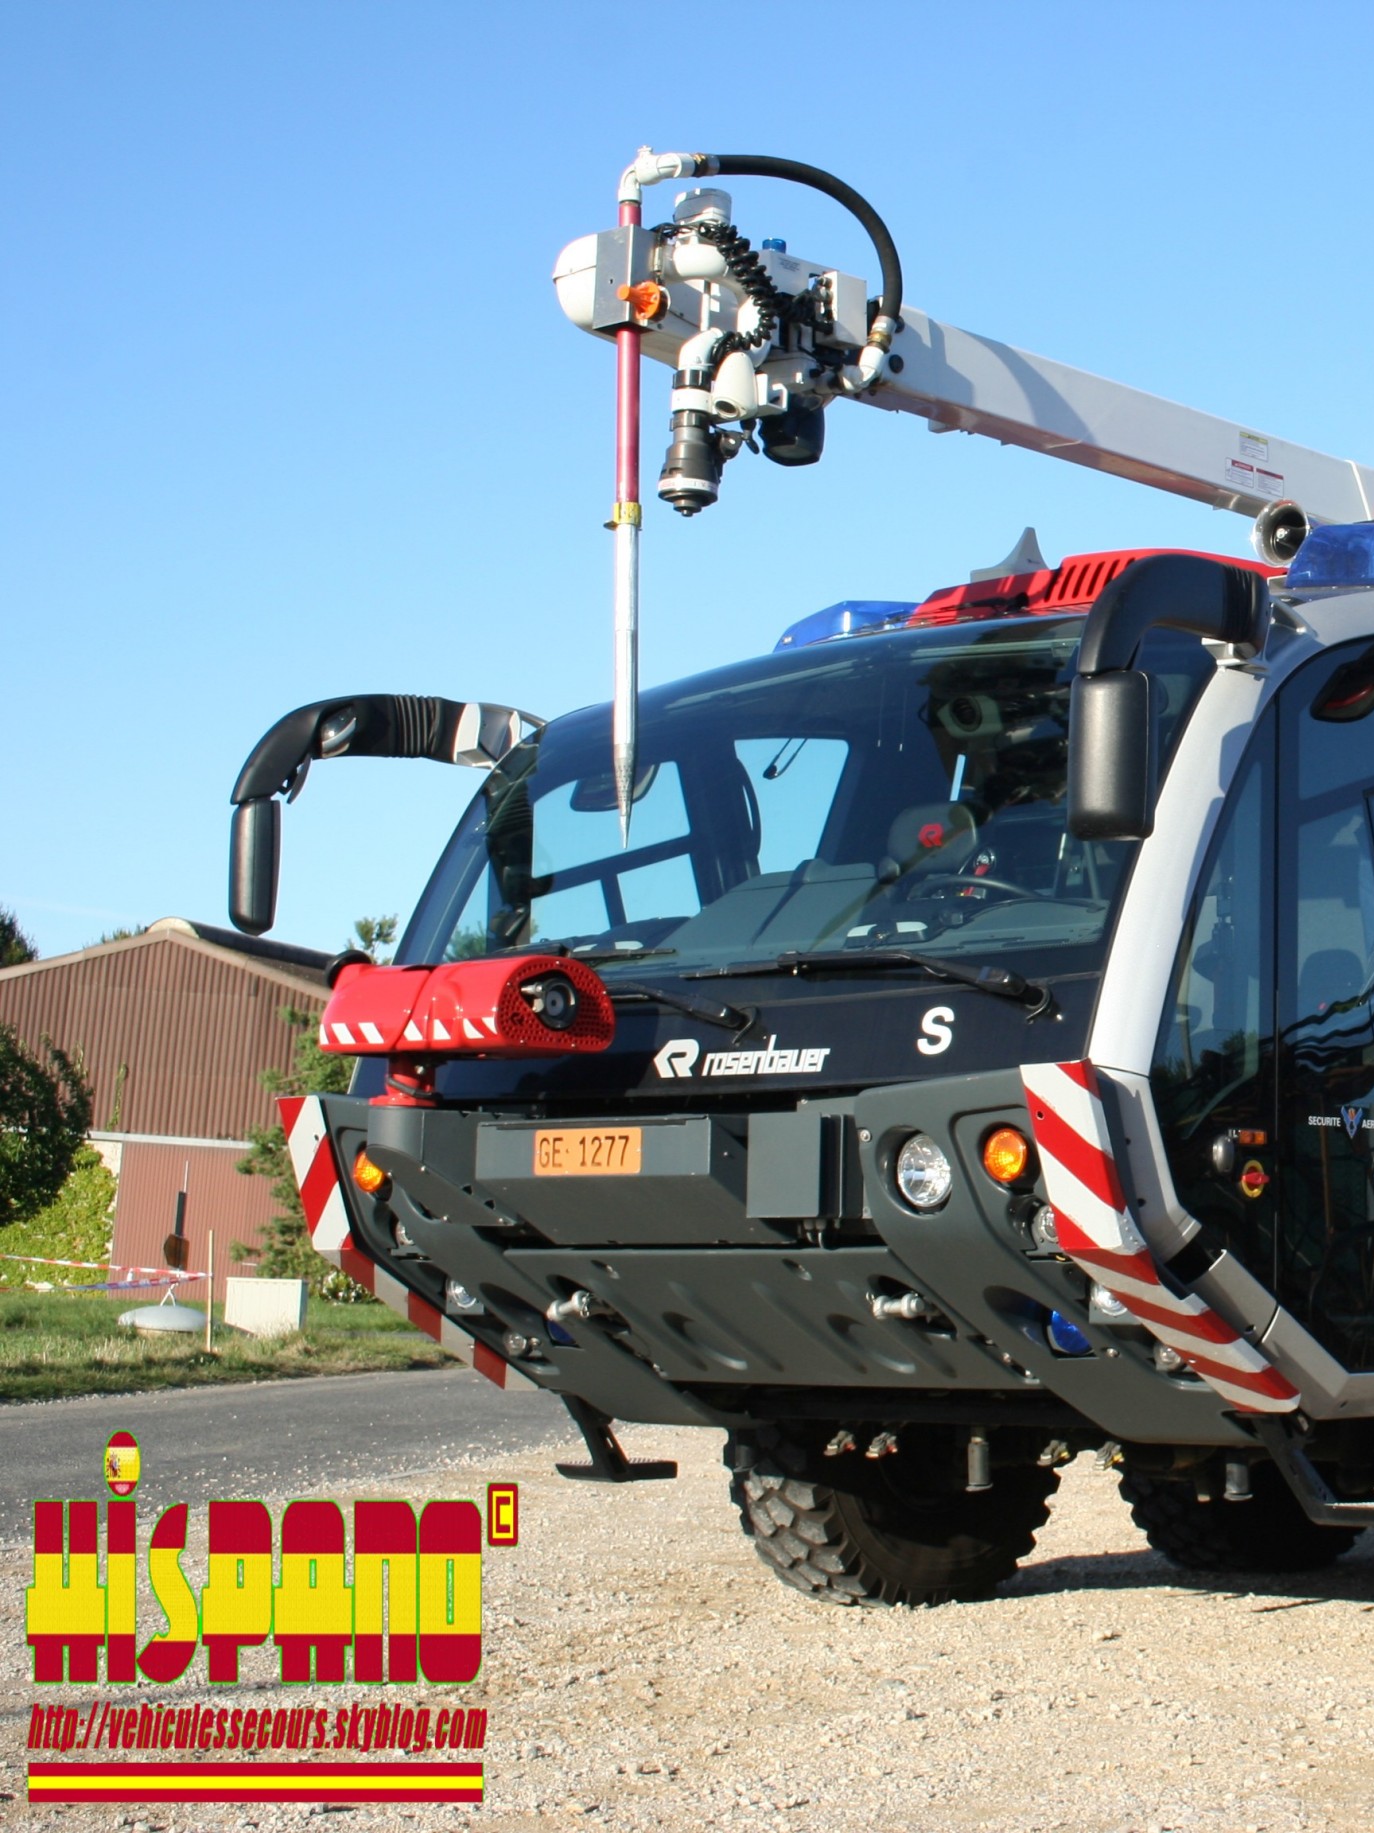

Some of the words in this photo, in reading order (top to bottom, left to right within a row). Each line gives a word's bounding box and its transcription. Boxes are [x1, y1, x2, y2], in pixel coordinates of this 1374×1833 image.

[916, 1006, 955, 1056] S
[701, 1034, 831, 1077] rosenbauer
[1308, 1116, 1341, 1127] SECURITE
[539, 1136, 563, 1168] GE
[579, 1135, 630, 1167] 1277
